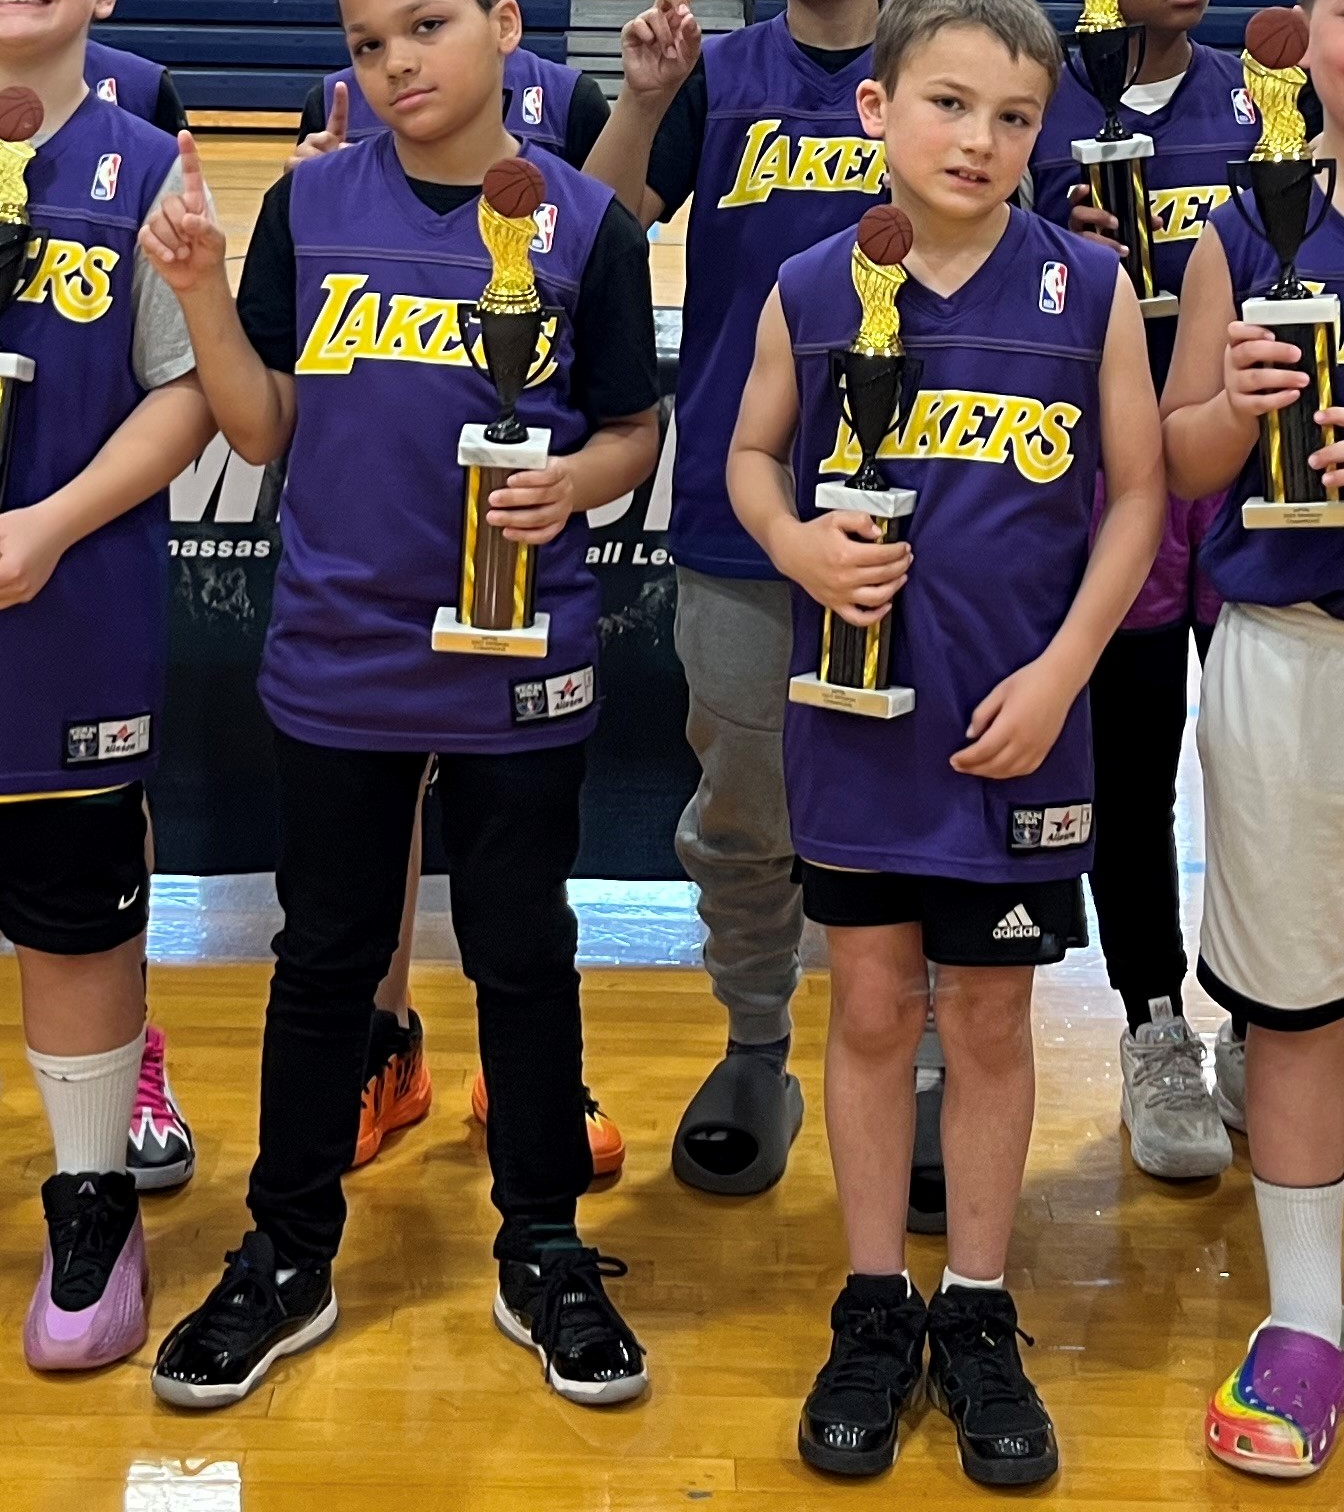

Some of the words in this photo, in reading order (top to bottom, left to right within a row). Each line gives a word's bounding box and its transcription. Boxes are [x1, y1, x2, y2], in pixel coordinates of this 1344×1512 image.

[585, 541, 623, 564] all
[631, 542, 675, 565] Le
[992, 925, 1041, 939] adidas
